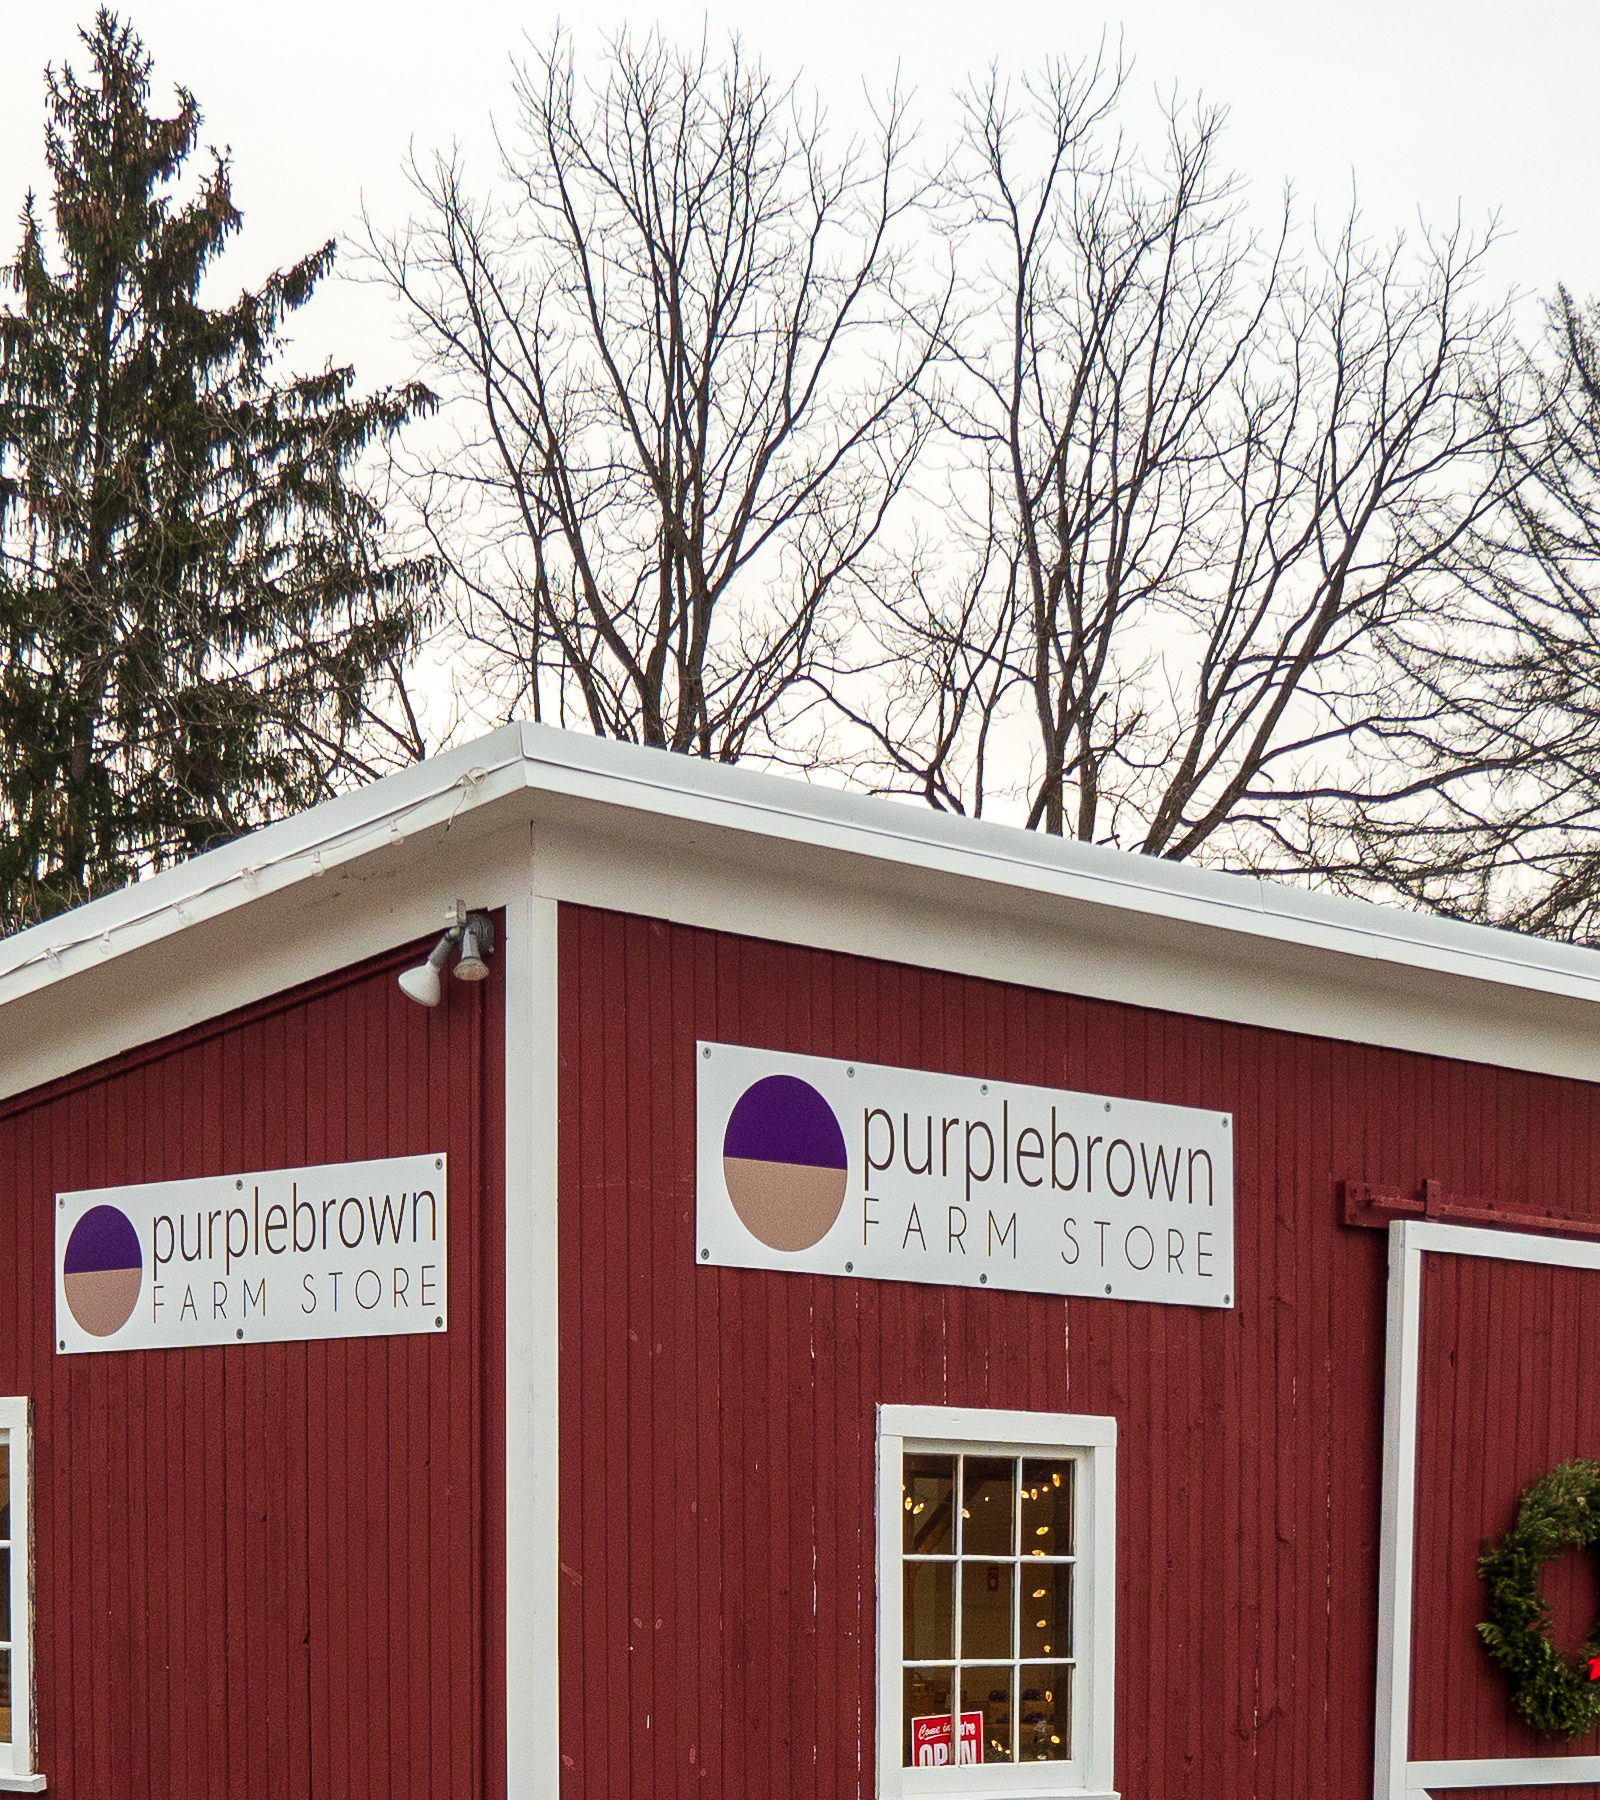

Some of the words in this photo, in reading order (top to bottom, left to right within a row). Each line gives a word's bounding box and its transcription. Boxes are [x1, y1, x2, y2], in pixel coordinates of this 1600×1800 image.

[864, 1100, 1214, 1207] purplebrown
[153, 1182, 437, 1282] purplebrown
[864, 1197, 1017, 1260] FARM
[1061, 1217, 1213, 1277] STORE
[153, 1277, 267, 1324] FARM
[301, 1265, 436, 1314] STORE
[919, 1741, 977, 1766] OPN
